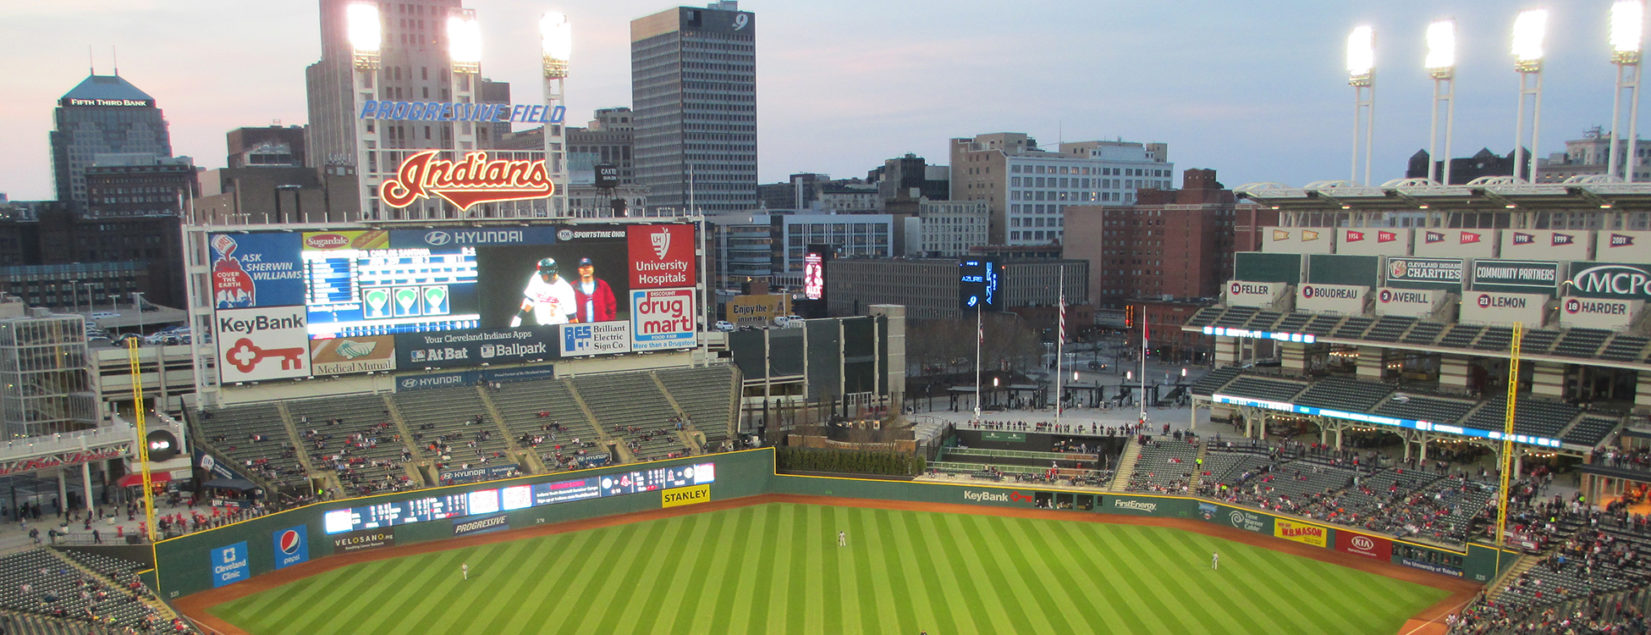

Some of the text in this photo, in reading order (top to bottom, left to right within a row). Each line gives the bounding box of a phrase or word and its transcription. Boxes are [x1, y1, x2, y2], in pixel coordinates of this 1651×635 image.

[96, 98, 123, 106] THIRD
[123, 98, 147, 106] BANK
[360, 100, 567, 123] PROGRESSIVE FIELD
[381, 149, 555, 211] Indians
[308, 236, 349, 248] Sugardale
[455, 230, 523, 243] HYUNDAI
[241, 253, 262, 262] ASK
[246, 262, 293, 272] SHERWIN
[635, 259, 688, 272] University
[253, 271, 302, 280] WILLIAMS
[638, 272, 686, 286] Hospitals
[1407, 268, 1462, 279] CHARITIES
[1477, 266, 1555, 281] COMMUNITY PARTNERS
[1241, 284, 1269, 295] FELLER
[1314, 287, 1357, 299] BOUDREAU
[1392, 292, 1429, 304] AVERILL
[1491, 296, 1526, 309] LEMON
[639, 291, 683, 318] drug
[733, 304, 767, 315] Enjoy the
[1581, 302, 1626, 315] HARDER
[220, 314, 304, 334] KeyBank
[593, 325, 625, 333] Brilliant
[644, 316, 693, 334] mart
[424, 331, 533, 344] Your Cleveland Indians Apps
[593, 333, 624, 341] Electric
[496, 342, 546, 357] Ballpark
[593, 342, 611, 351] Sign
[427, 347, 468, 361] At Bat
[317, 360, 391, 374] Medical Mutual
[419, 375, 462, 386] HYUNDAI
[454, 468, 486, 478] HYUNDAI
[664, 489, 708, 502] STANLEY
[964, 490, 1009, 502] KeyBank
[1114, 499, 1157, 511] FirstEnergy
[455, 516, 507, 533] PROGRESSIVE
[1355, 538, 1371, 548] KIA
[215, 558, 247, 574] Cleveland
[283, 555, 300, 565] pepsi
[1402, 559, 1411, 567] The
[1411, 561, 1435, 572] University
[222, 570, 240, 581] Clinic
